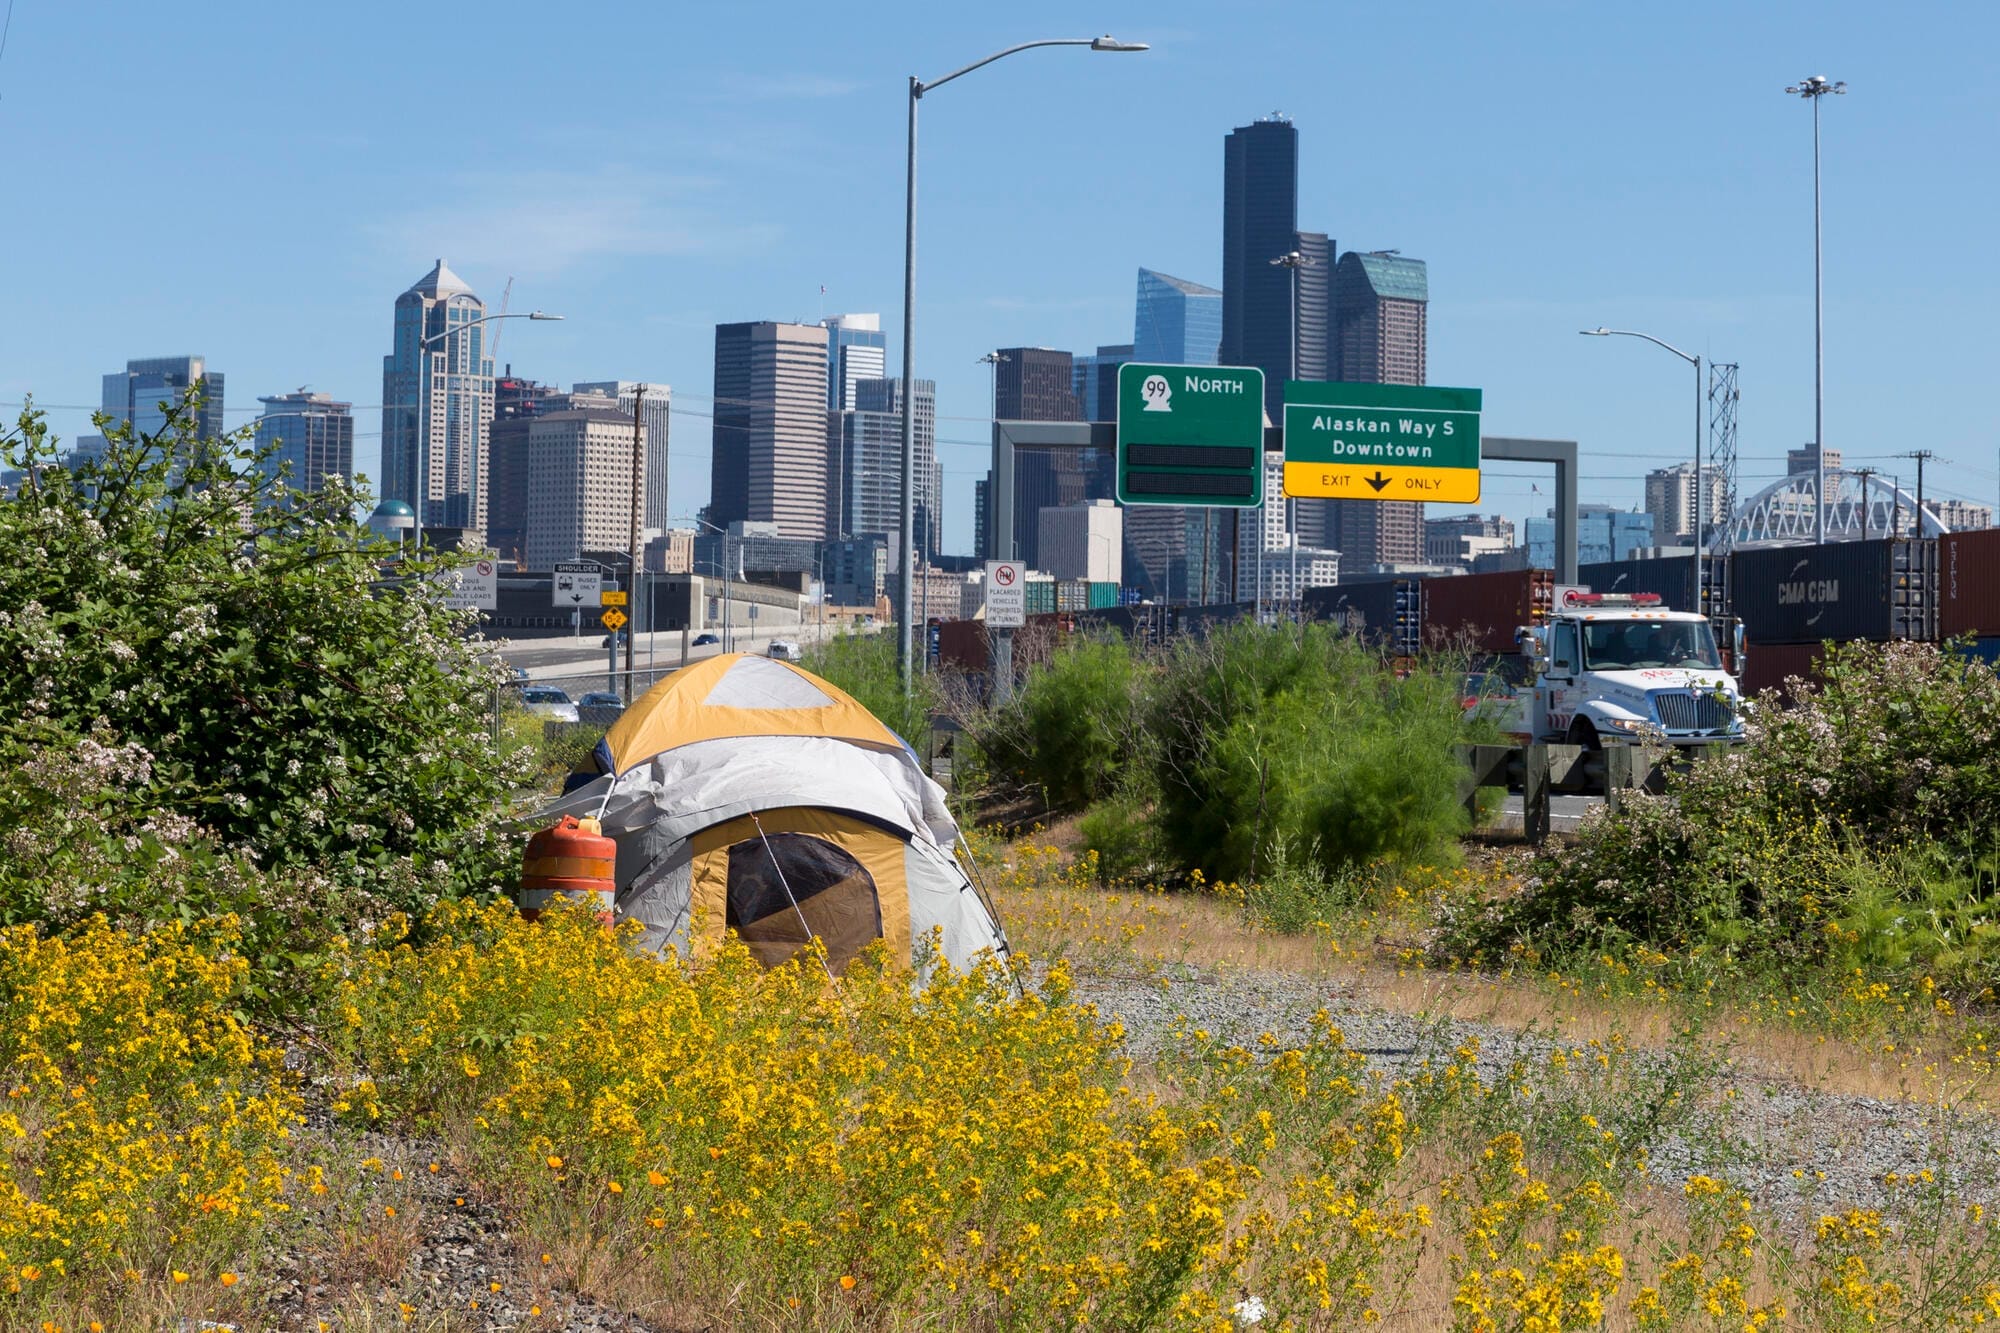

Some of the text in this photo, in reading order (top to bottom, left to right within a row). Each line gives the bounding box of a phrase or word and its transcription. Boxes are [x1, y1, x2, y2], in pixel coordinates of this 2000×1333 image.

[1147, 381, 1166, 398] 99
[1185, 375, 1244, 394] NORTH
[1312, 415, 1455, 438] Alaskan Way S
[1333, 440, 1432, 458] Downtown
[1322, 475, 1442, 490] EXIT ONLY
[989, 588, 1021, 596] PLACARDED
[1778, 579, 1839, 604] CMA CGM
